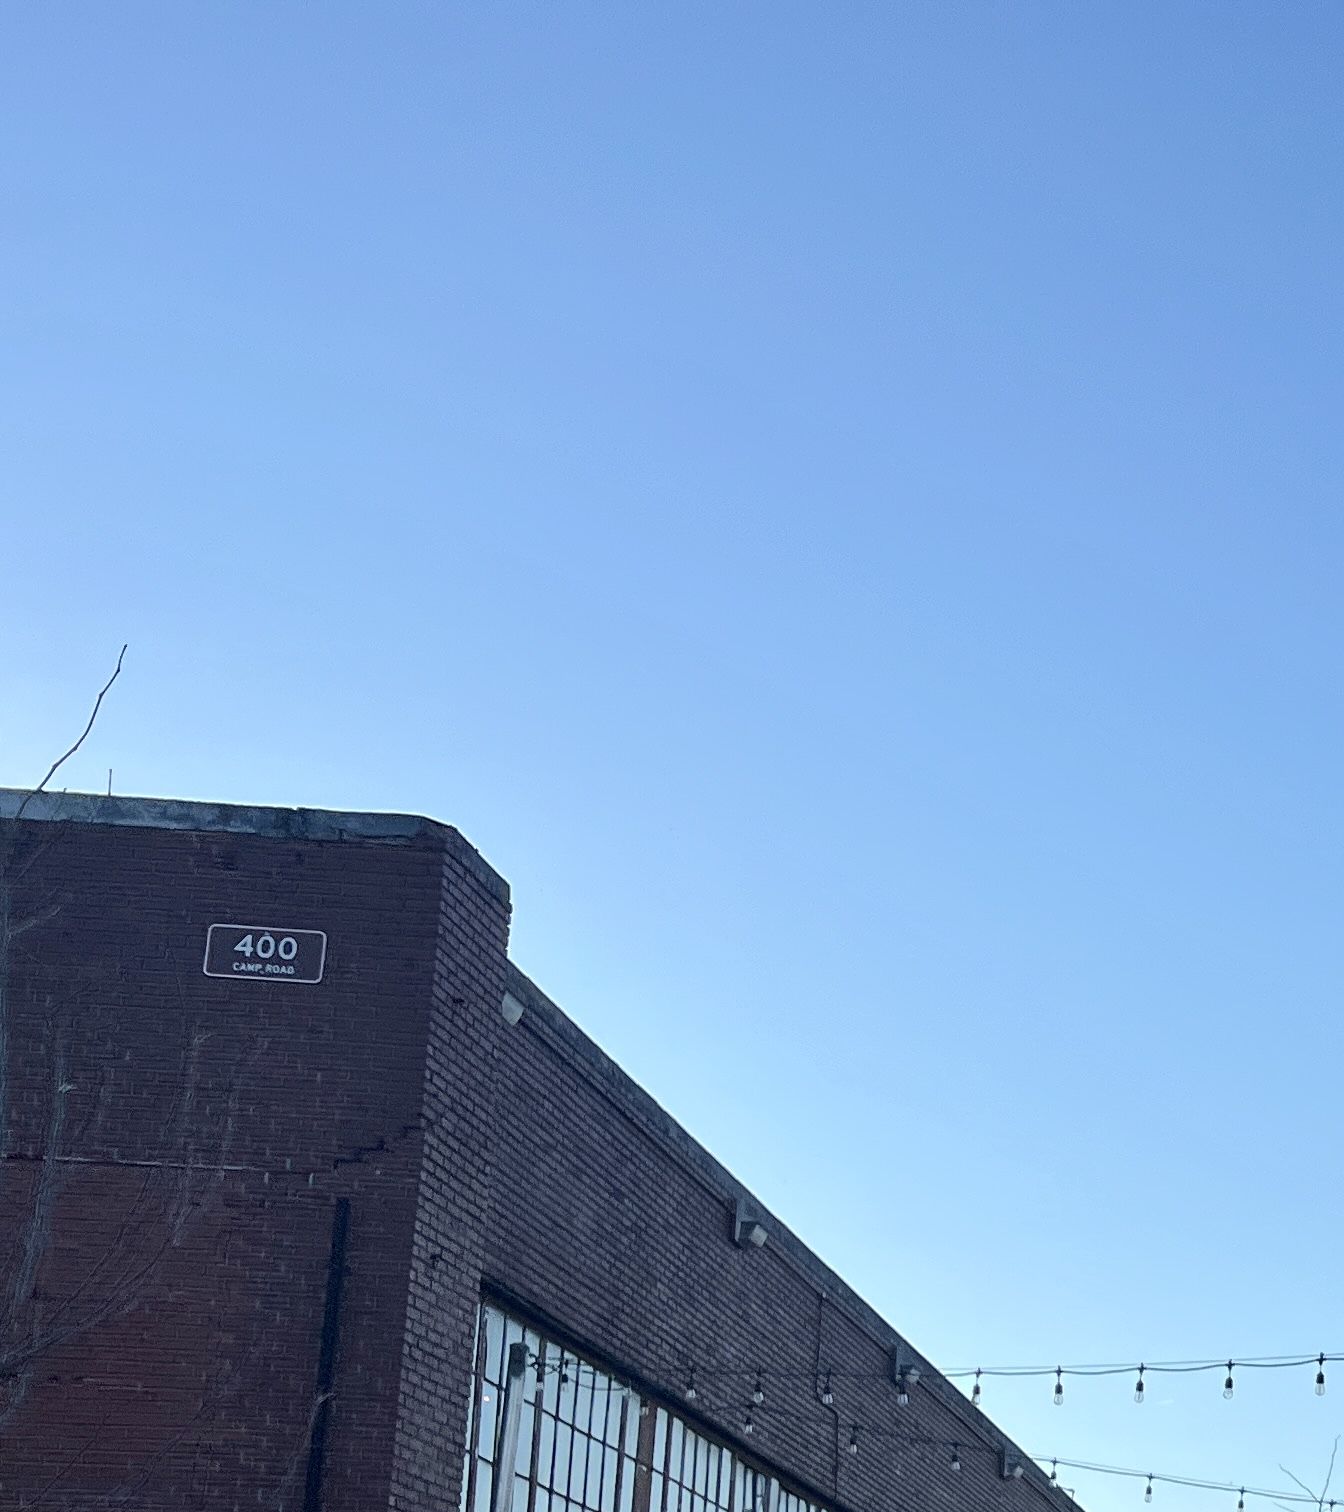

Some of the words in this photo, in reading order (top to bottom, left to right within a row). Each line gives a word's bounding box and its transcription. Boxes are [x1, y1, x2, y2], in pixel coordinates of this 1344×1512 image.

[233, 934, 298, 960] 400
[232, 962, 263, 973] CAMP
[265, 964, 296, 975] ROAD
